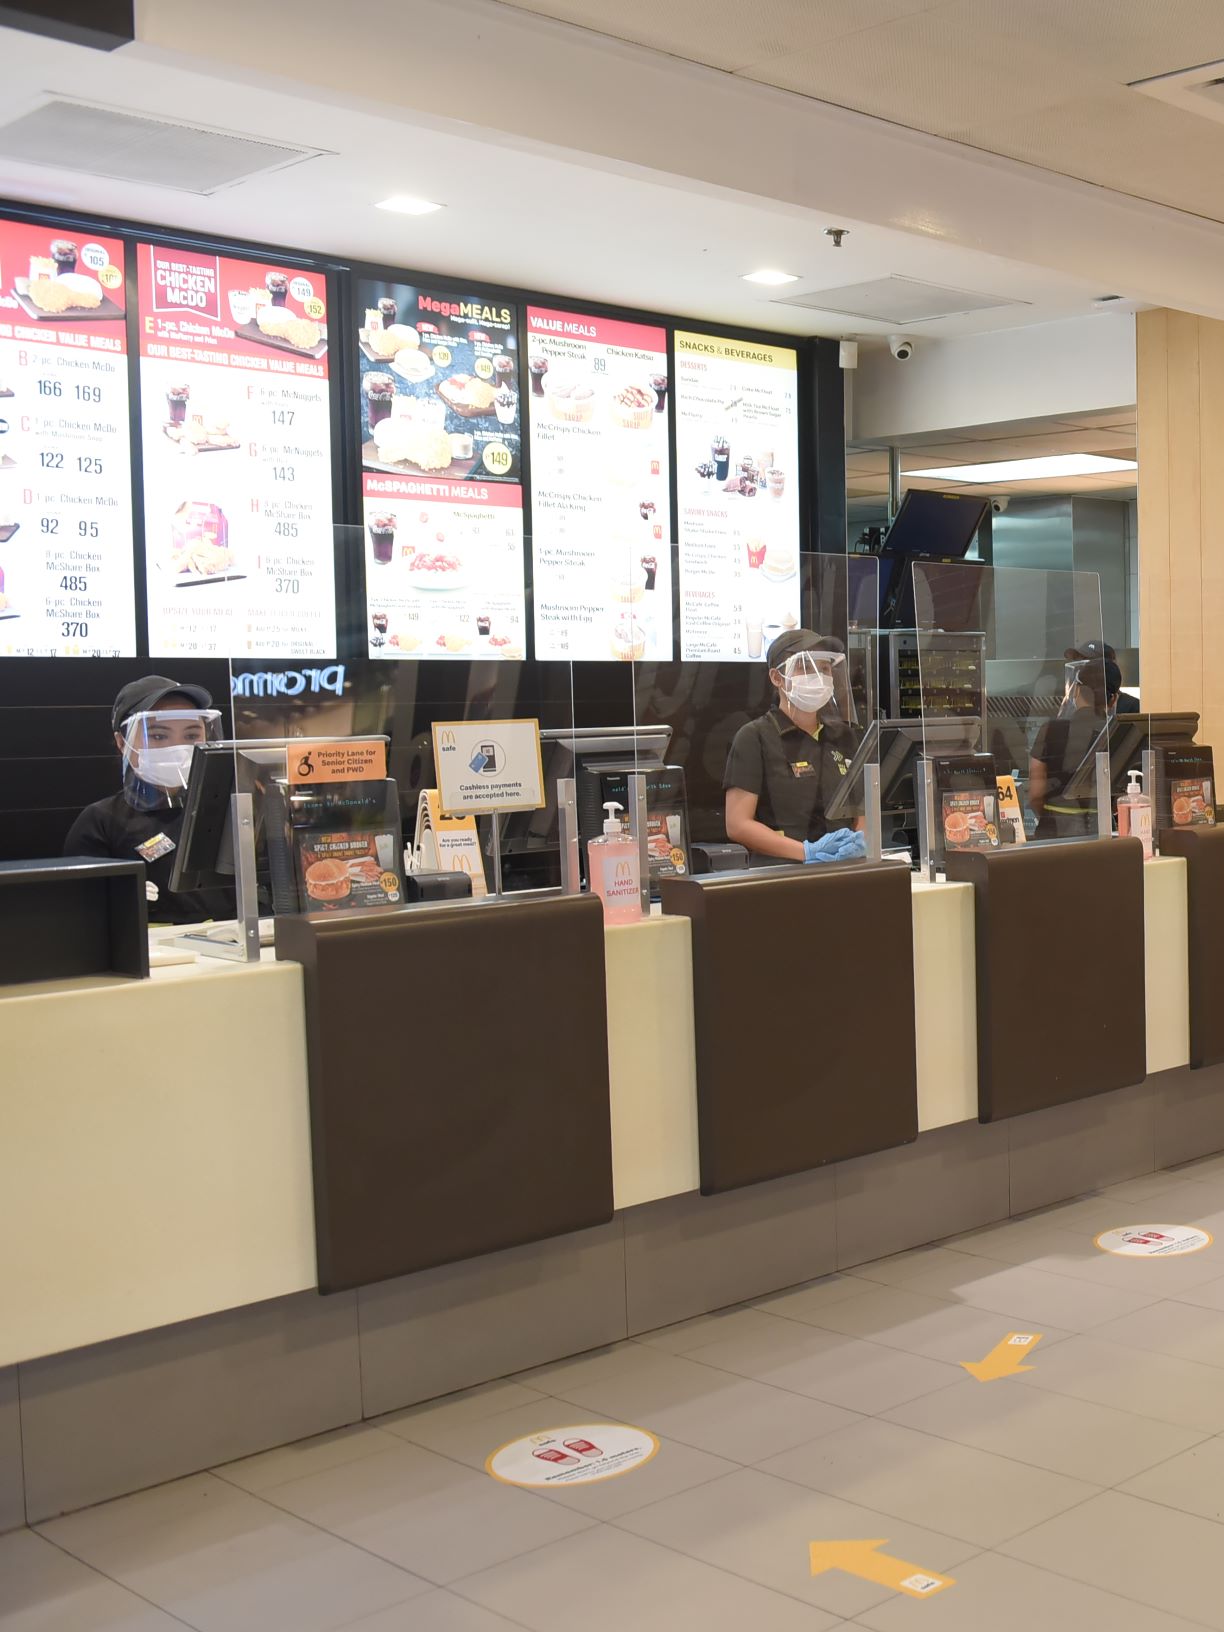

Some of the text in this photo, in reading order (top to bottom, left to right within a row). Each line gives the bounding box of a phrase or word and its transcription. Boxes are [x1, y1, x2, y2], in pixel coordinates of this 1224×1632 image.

[90, 255, 105, 268] 105
[157, 260, 215, 277] OUR BEST-TASTING
[156, 269, 216, 294] CHICKEN
[166, 287, 207, 308] McDO
[308, 304, 323, 315] 152
[145, 316, 155, 334] E
[179, 320, 210, 335] Chicken
[530, 316, 597, 337] VALUE MEALS
[58, 331, 89, 347] VALUE
[89, 335, 122, 352] MEALS
[548, 338, 587, 351] Mushroom
[541, 346, 587, 360] Pepper Steak
[606, 347, 655, 361] Chicken Katsu
[679, 339, 774, 363] SNACKS & BEVERAGES
[18, 350, 28, 367] B
[57, 356, 90, 370] Chicken
[147, 343, 324, 377] OUR BEST-TASTING CHICKEN VALUE MEALS
[593, 357, 607, 372] 89
[37, 379, 102, 404] 166 169
[281, 389, 323, 402] McNuggets
[21, 415, 31, 432] C
[58, 419, 91, 431] Chicken
[272, 409, 295, 426] 147
[536, 422, 571, 434] McCrispy
[283, 445, 324, 458] McNuggets
[490, 451, 508, 466] 149
[39, 452, 104, 475] 122 125
[272, 466, 295, 482] 143
[366, 478, 489, 500] McSPAGHETTI MEALS
[538, 490, 572, 501] McCrispy
[23, 488, 33, 505] D
[40, 517, 100, 538] 92 95
[274, 521, 299, 538] 485
[69, 550, 103, 561] Chicken
[555, 548, 596, 558] Mushroom
[46, 561, 101, 573] McShare Box
[539, 557, 563, 567] Pepper
[60, 575, 88, 592] 485
[275, 577, 300, 595] 370
[69, 597, 103, 608] Chicken
[540, 603, 605, 614] Mushroom Pepper
[46, 608, 101, 619] McShare Box
[540, 613, 560, 621] Steak
[61, 621, 89, 638] 370
[317, 750, 346, 759] Priority
[347, 749, 365, 757] Lane
[441, 744, 457, 752] safe
[321, 757, 373, 767] Senior Citizen
[331, 765, 365, 775] and PWD
[459, 782, 522, 792] Cashless payments
[997, 785, 1013, 801] 64
[474, 791, 505, 801] accepted
[505, 790, 522, 798] here.
[613, 879, 634, 887] HAND
[606, 888, 639, 897] SANITIZER
